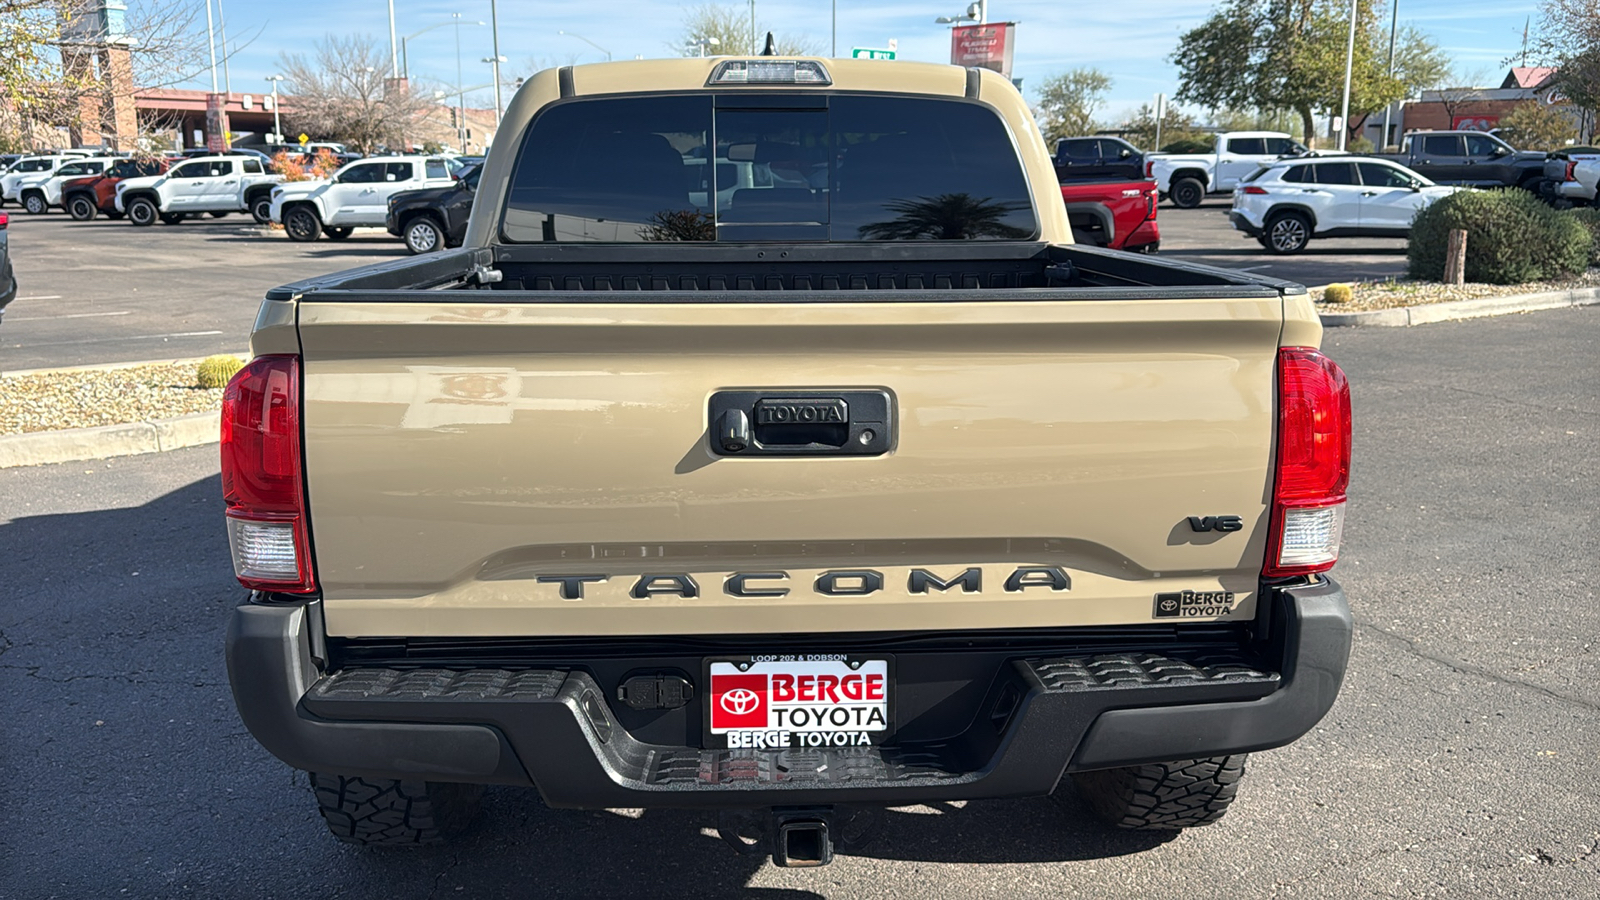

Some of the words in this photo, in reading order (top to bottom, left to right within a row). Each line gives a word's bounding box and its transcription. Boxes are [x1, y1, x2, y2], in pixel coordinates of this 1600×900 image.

[761, 405, 843, 423] TOYOTA
[1187, 515, 1243, 532] V6
[535, 564, 1073, 600] TACOMA
[1182, 591, 1234, 605] BERGE
[1181, 605, 1231, 617] TOYOTA
[807, 654, 848, 662] DOBSON
[771, 674, 884, 704] BERGE
[772, 707, 886, 727] TOYOTA
[727, 731, 791, 749] BERGE
[797, 732, 872, 747] TOYOTA
